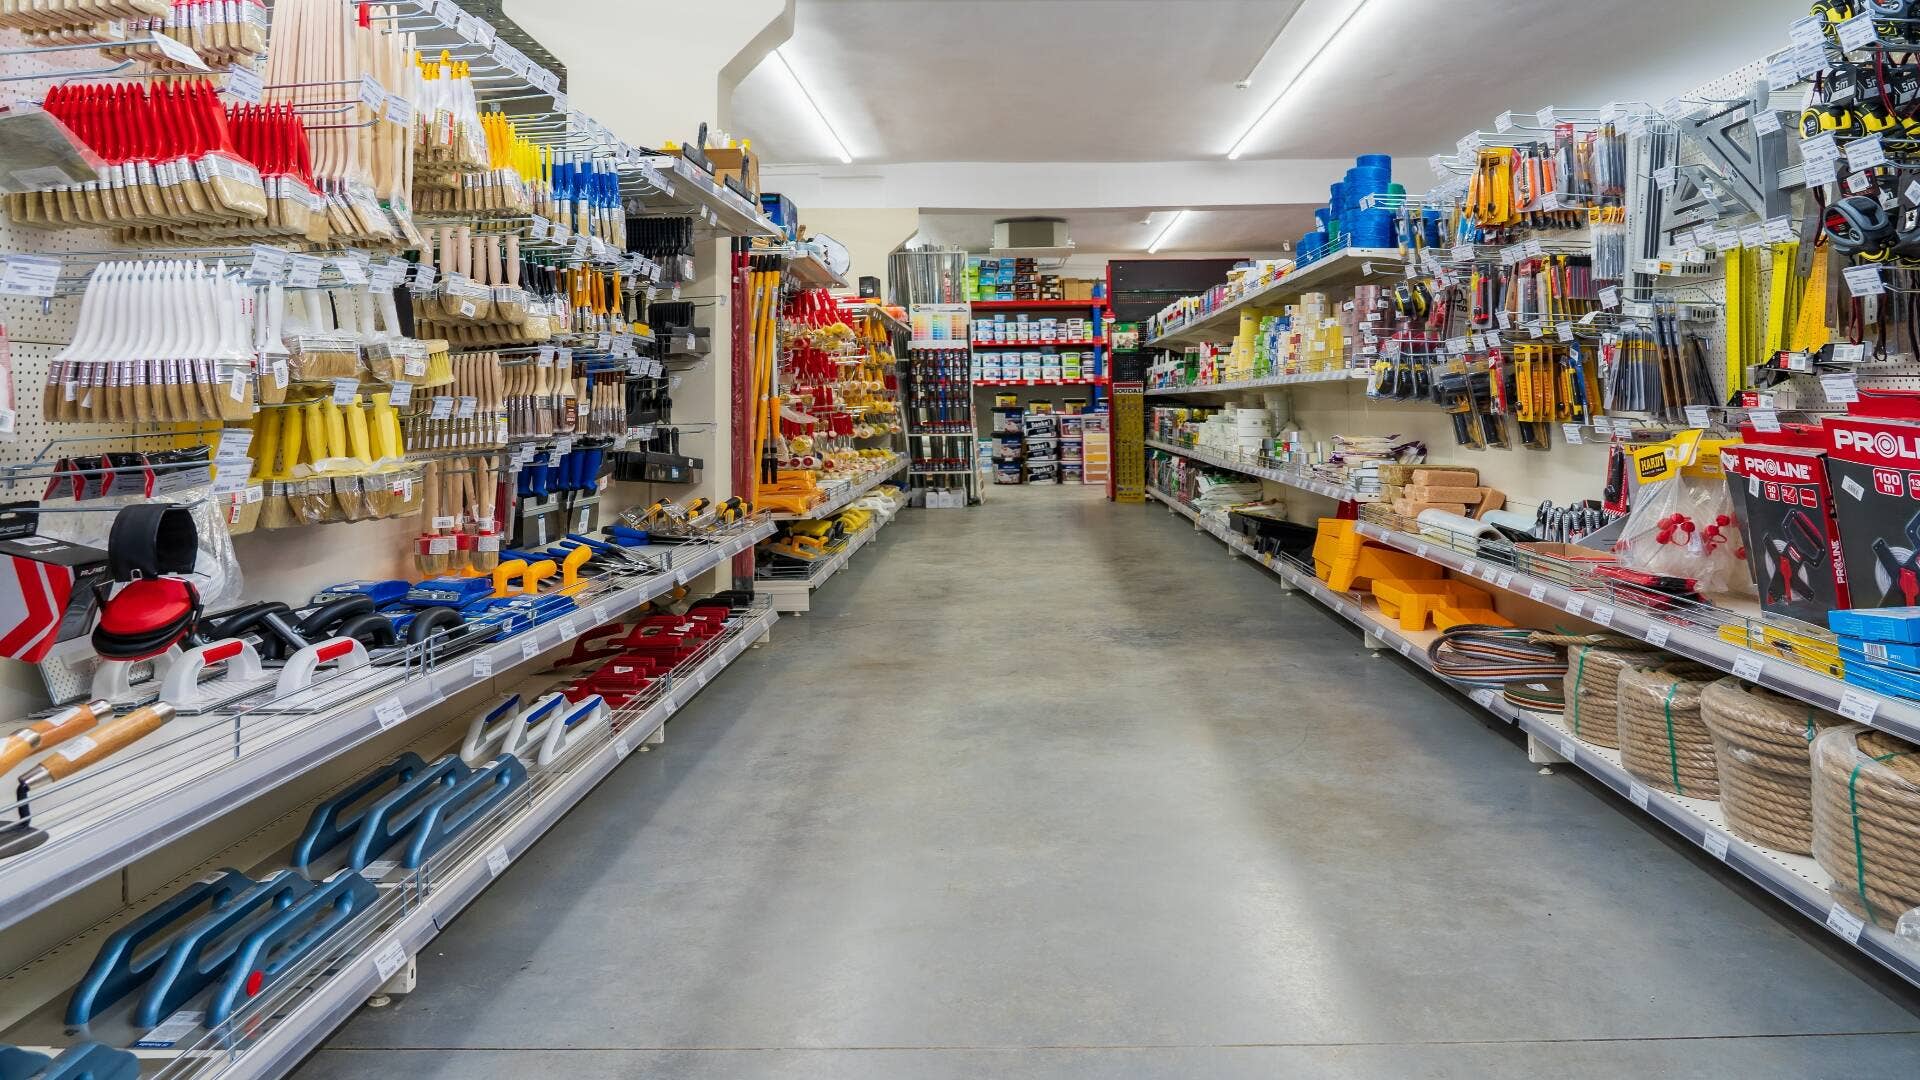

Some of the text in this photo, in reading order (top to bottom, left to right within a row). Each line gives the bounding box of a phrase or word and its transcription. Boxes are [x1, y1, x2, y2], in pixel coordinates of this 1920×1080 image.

[1835, 79, 1849, 91] 5m
[1901, 80, 1918, 92] 5m
[1641, 454, 1665, 472] HARDY
[1744, 456, 1811, 481] PROLINE
[1876, 471, 1901, 486] 100
[1767, 485, 1776, 494] 50
[1884, 484, 1895, 493] m
[1830, 540, 1846, 584] PROLINE
